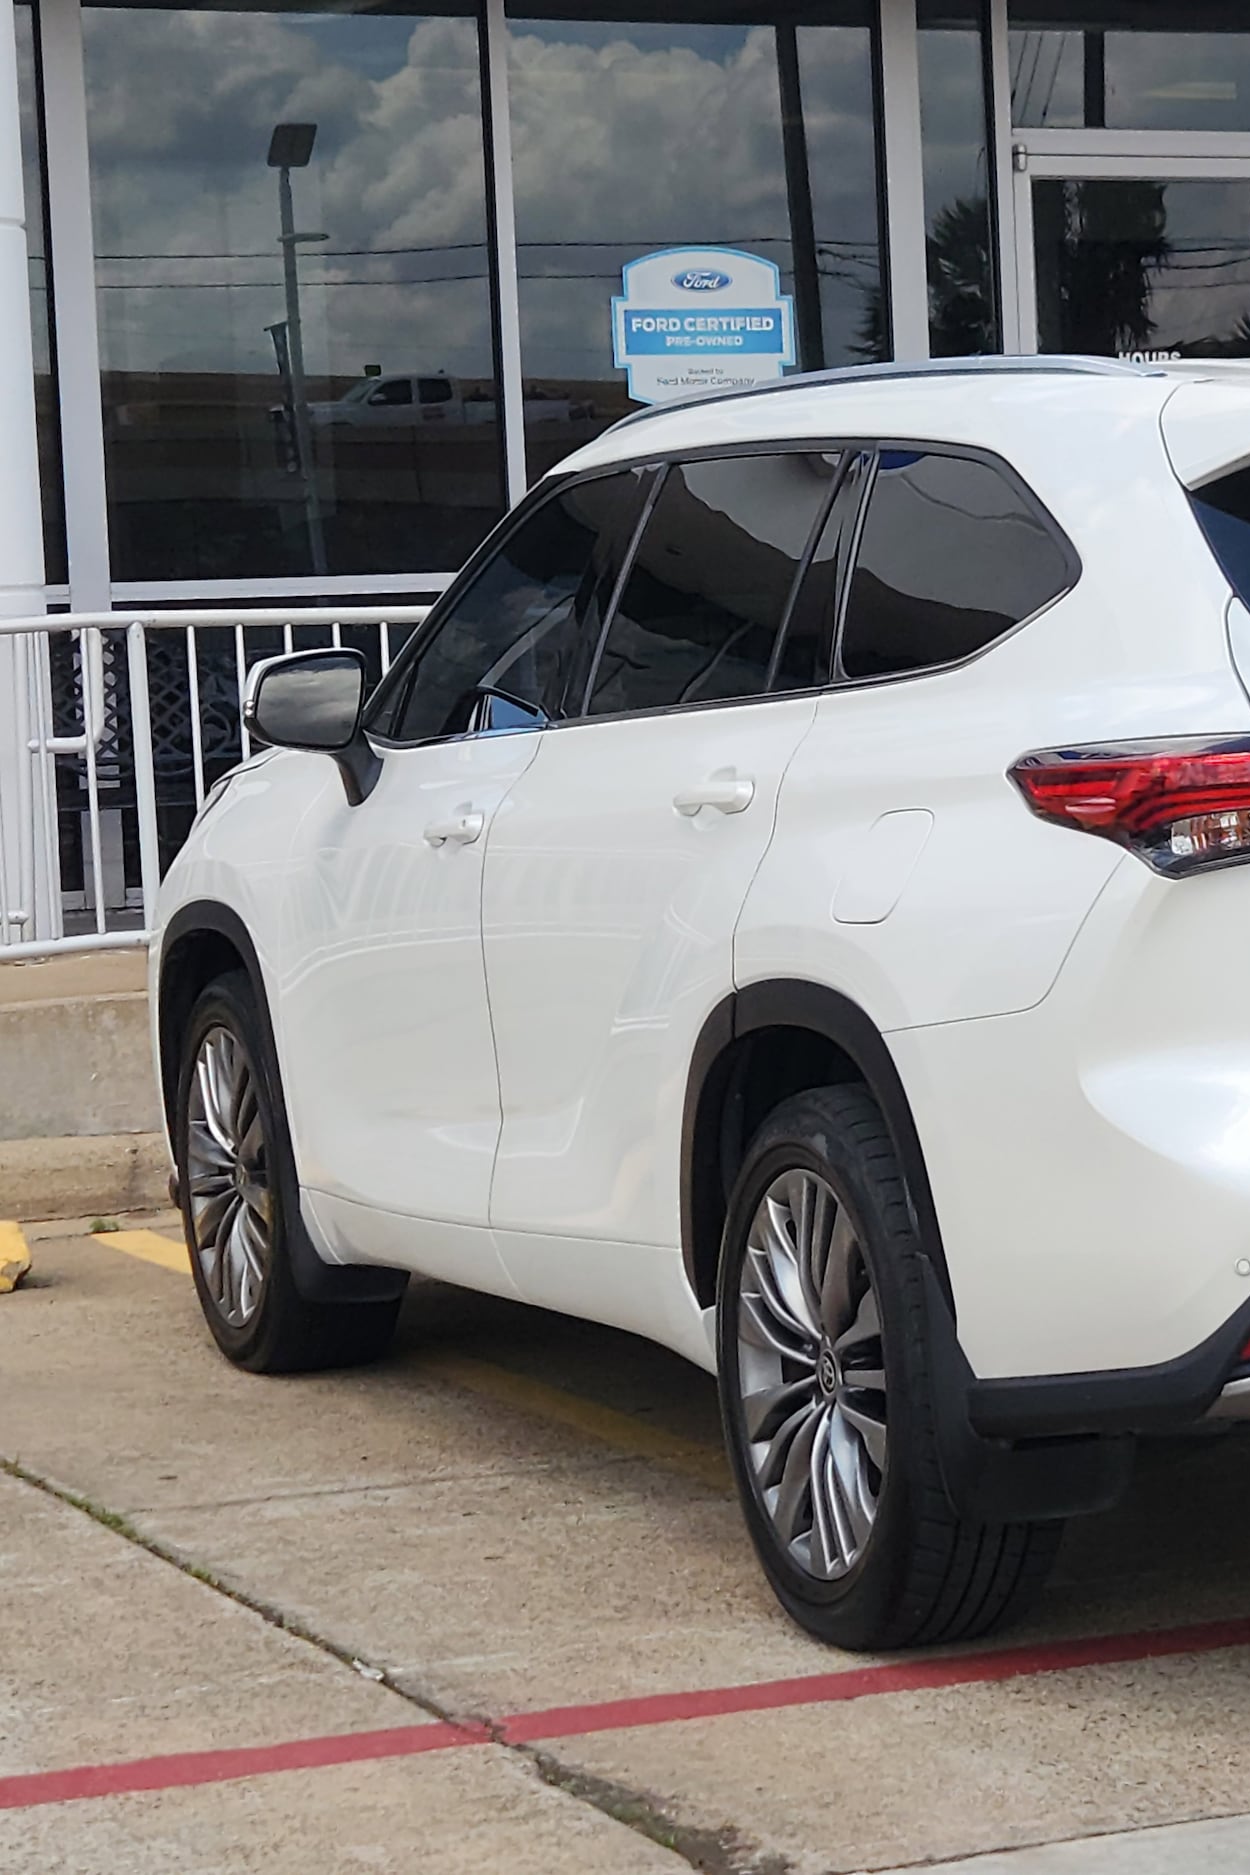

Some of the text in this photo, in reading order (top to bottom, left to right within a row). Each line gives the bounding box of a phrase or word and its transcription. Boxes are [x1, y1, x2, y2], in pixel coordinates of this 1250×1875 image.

[682, 271, 721, 289] Ford
[631, 317, 774, 332] FORD CERTIFIED
[665, 336, 743, 347] PRE-OWNED
